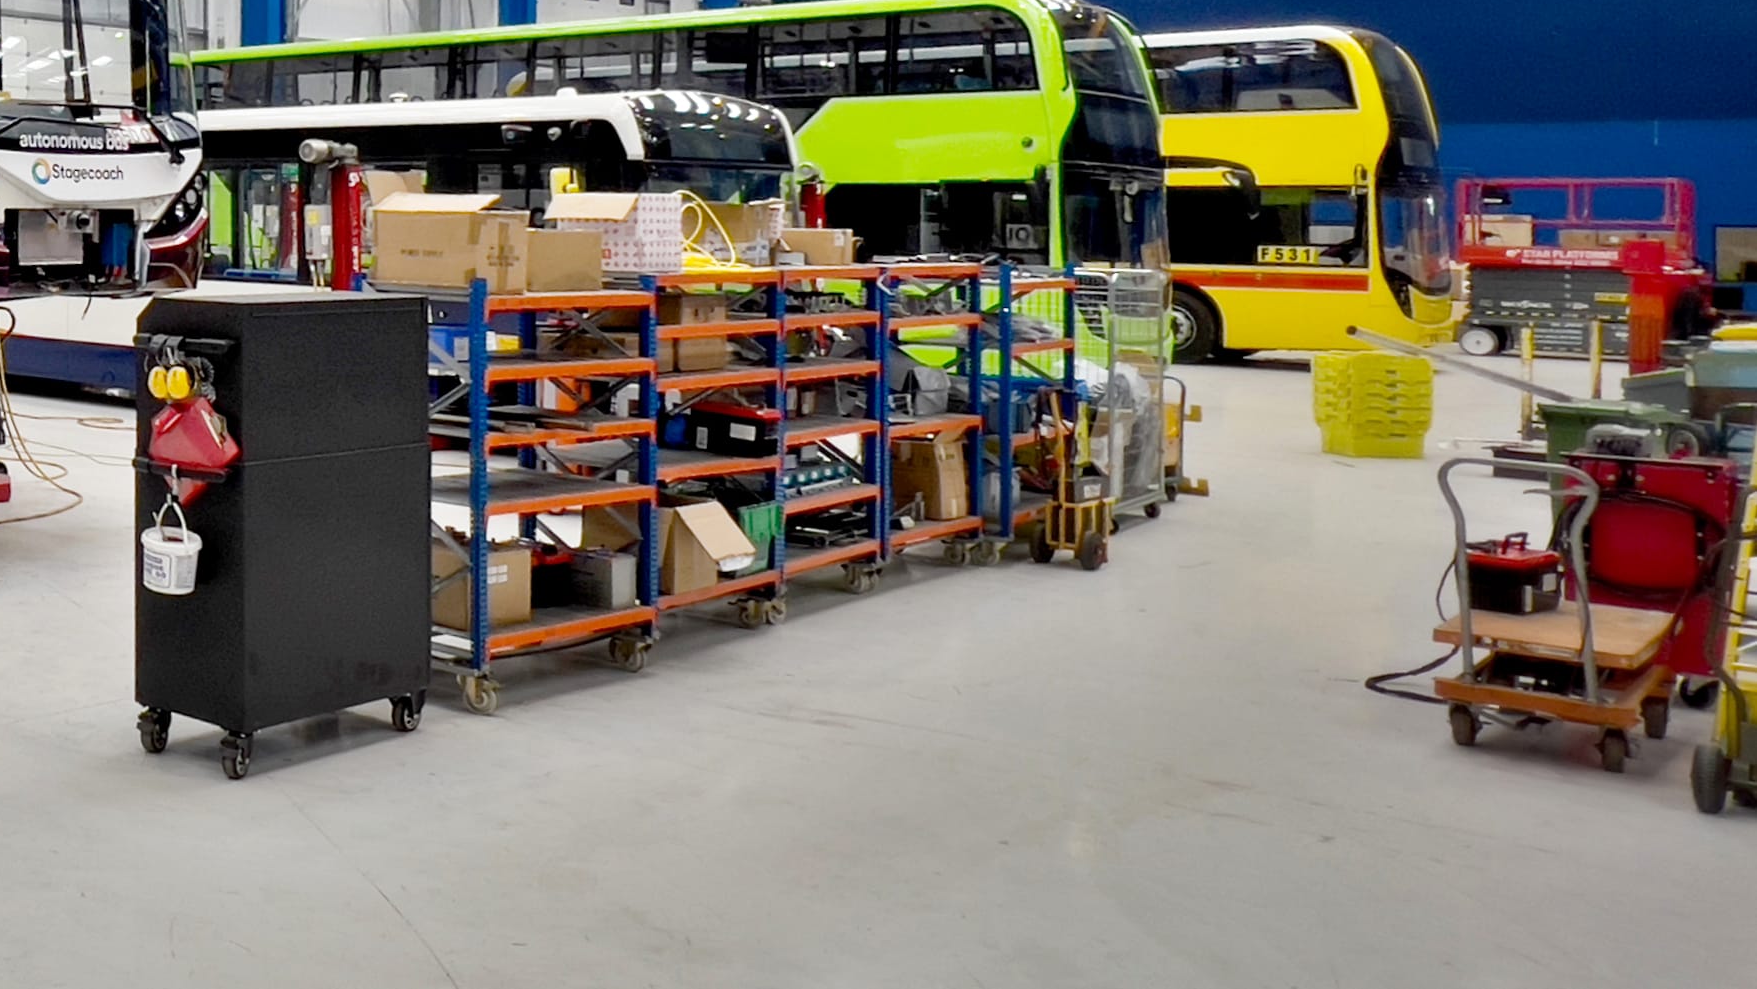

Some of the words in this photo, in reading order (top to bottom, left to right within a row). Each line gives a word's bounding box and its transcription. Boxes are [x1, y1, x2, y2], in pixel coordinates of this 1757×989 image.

[19, 132, 104, 151] autonomous
[51, 163, 125, 183] Stagecoach
[1261, 247, 1311, 261] F531
